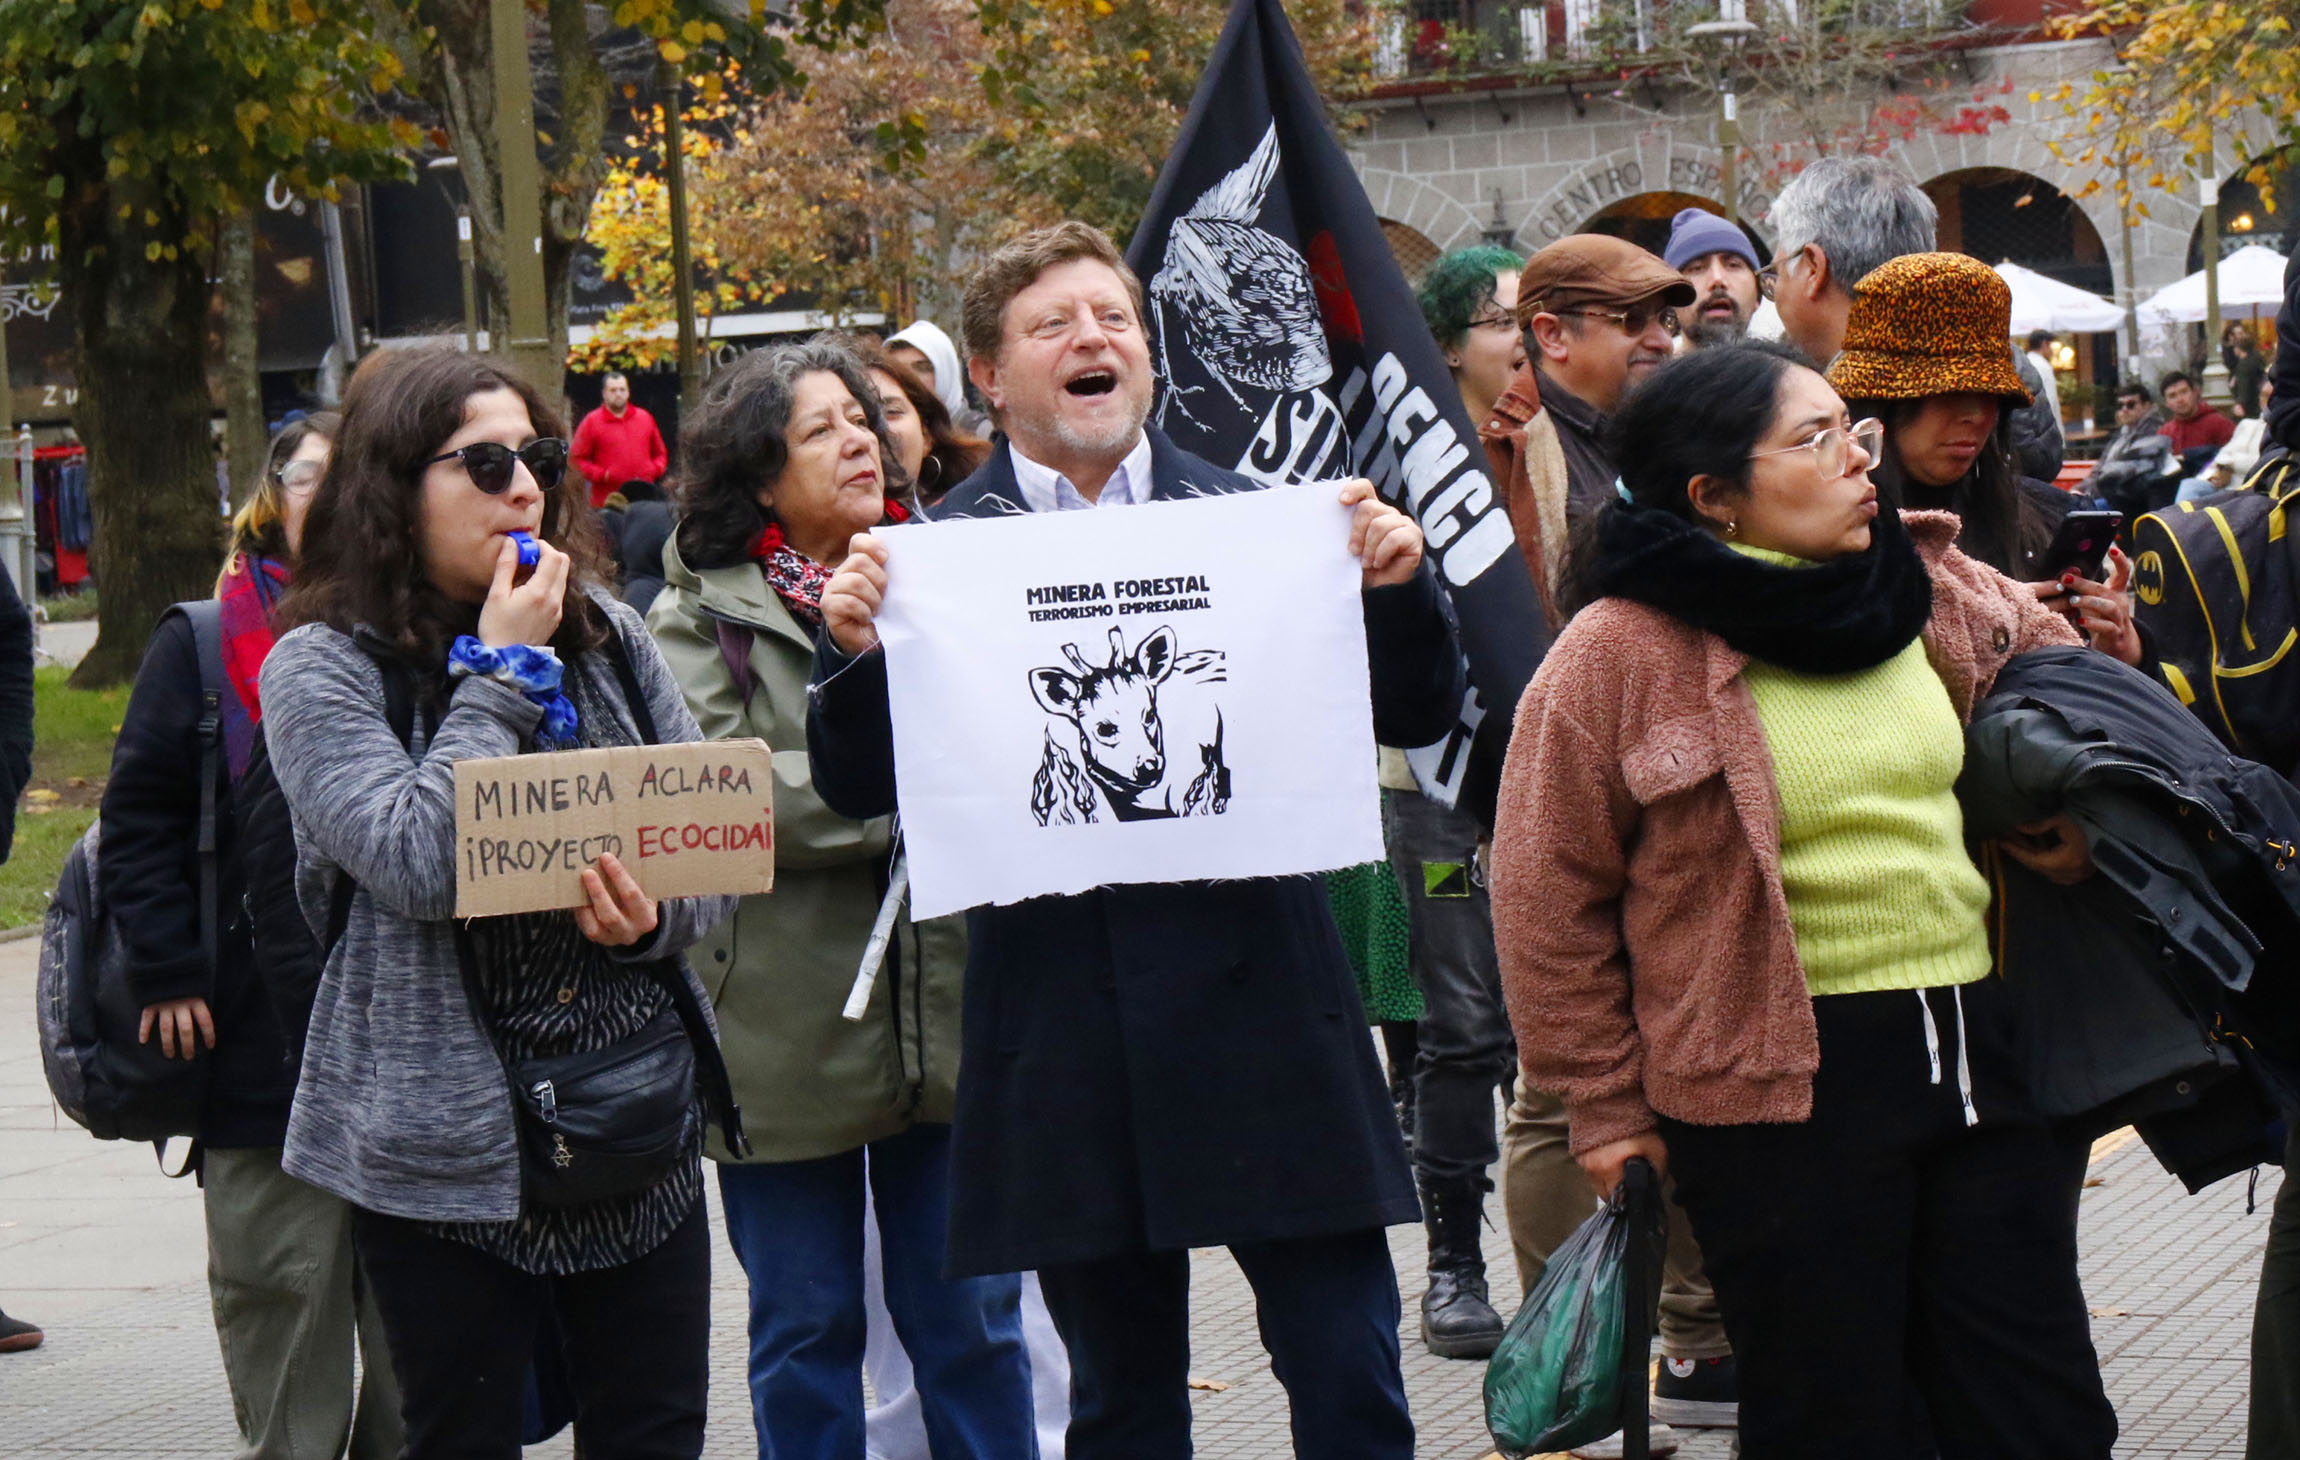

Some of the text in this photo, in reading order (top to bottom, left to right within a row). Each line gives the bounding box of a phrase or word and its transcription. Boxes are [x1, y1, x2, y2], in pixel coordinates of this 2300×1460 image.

[1539, 161, 1642, 240] CENTRO
[1026, 575, 1211, 606] MINERA FORESTAL
[1028, 597, 1212, 623] TERRORISMO EMPRESARIAL
[474, 762, 753, 821] MINERA ACLARA
